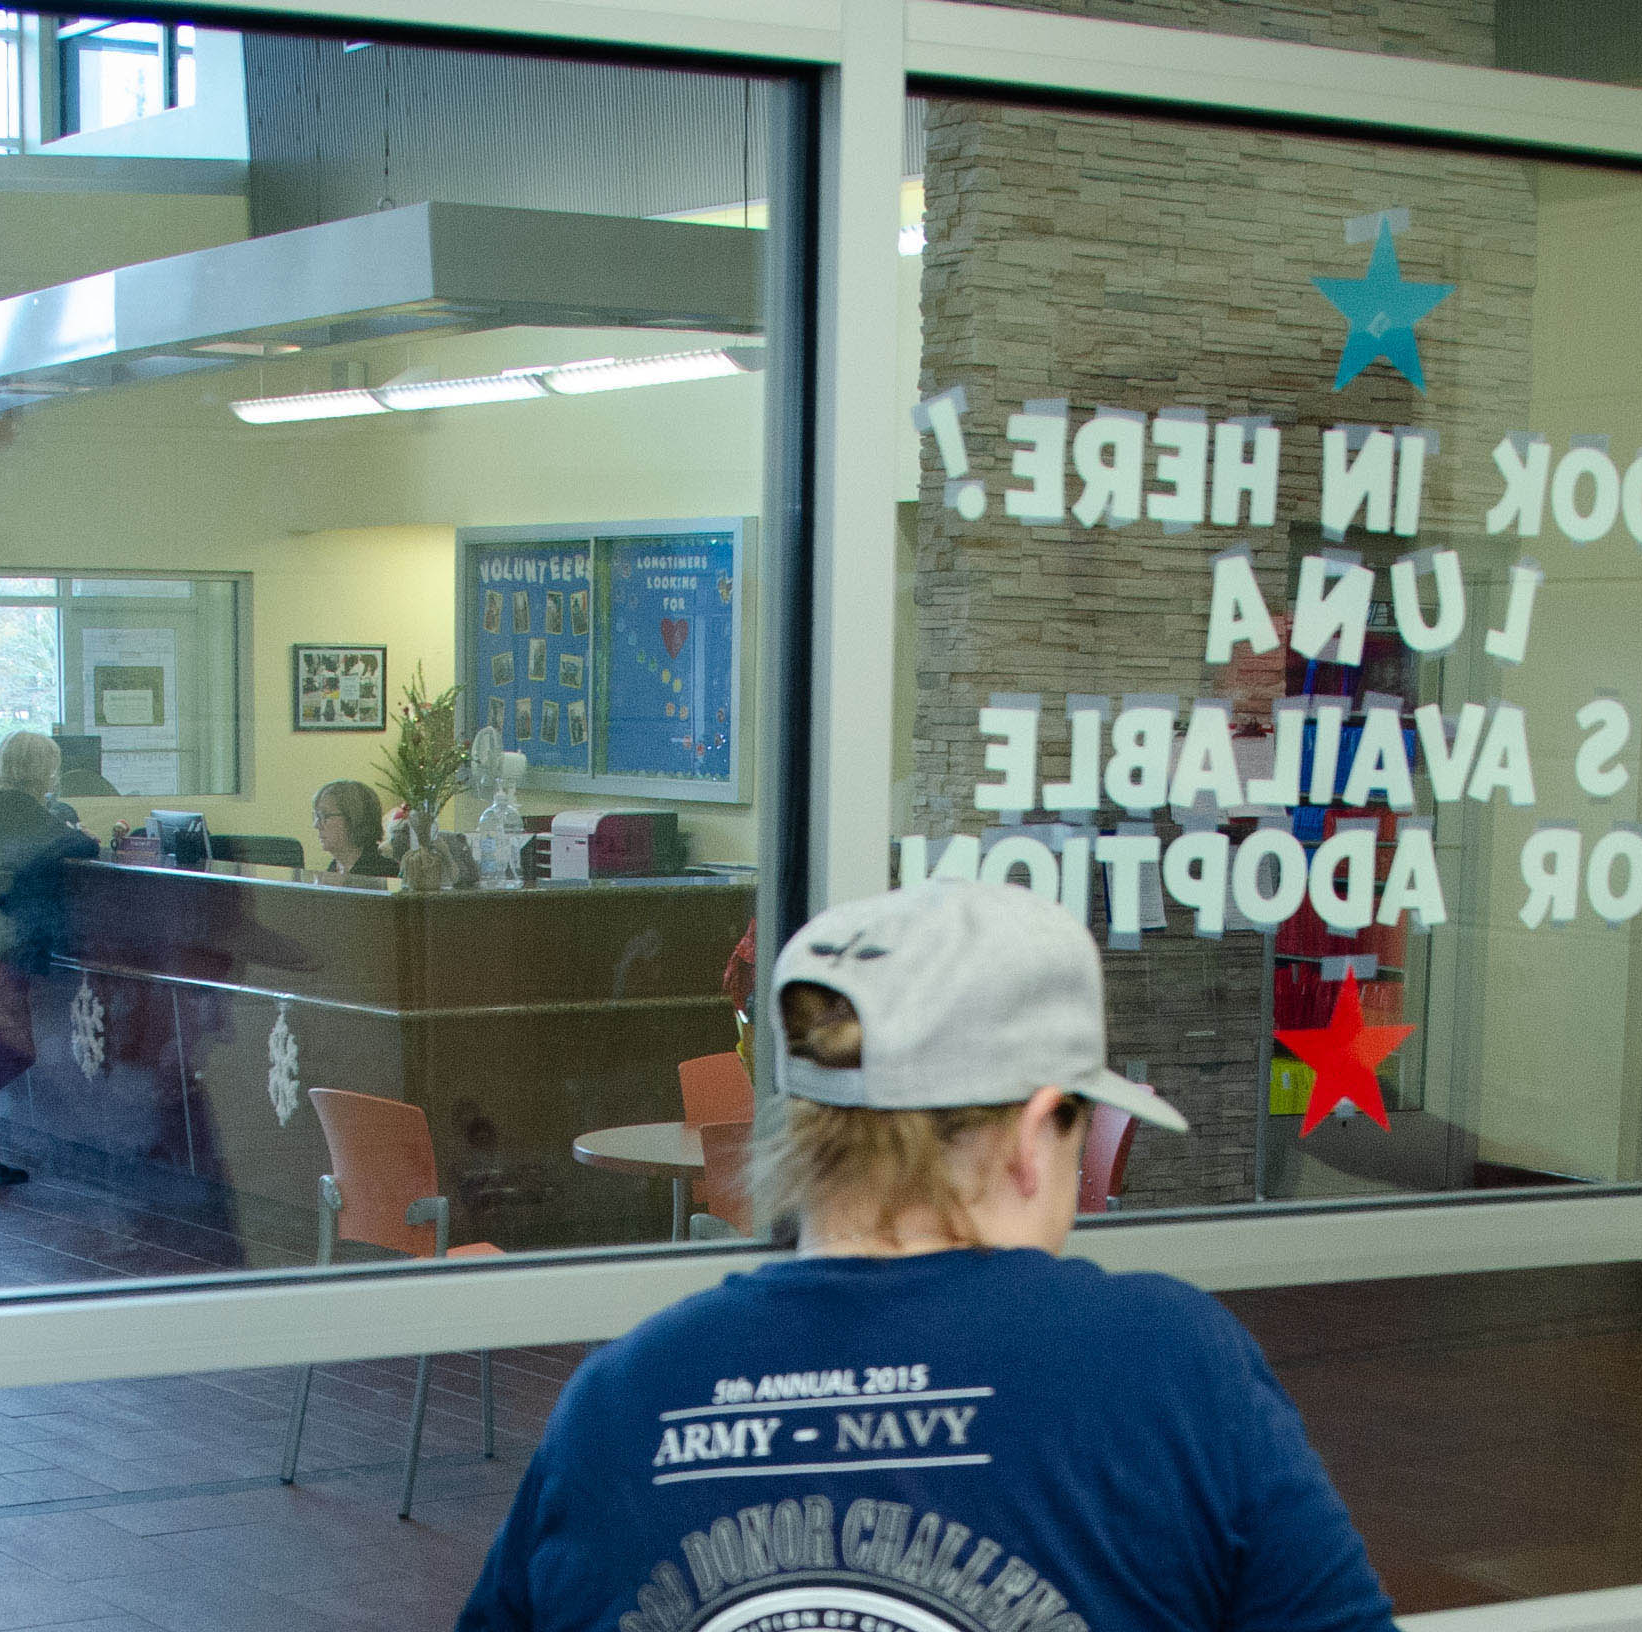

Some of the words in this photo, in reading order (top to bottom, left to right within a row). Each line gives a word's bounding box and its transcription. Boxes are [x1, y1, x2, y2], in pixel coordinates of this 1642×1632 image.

[662, 597, 686, 612] FOR
[755, 1369, 860, 1400] ANNUAL
[861, 1363, 930, 1394] 2015
[652, 1418, 783, 1467] ARMY
[835, 1406, 978, 1453] NAVY
[680, 1494, 837, 1602] DONOR
